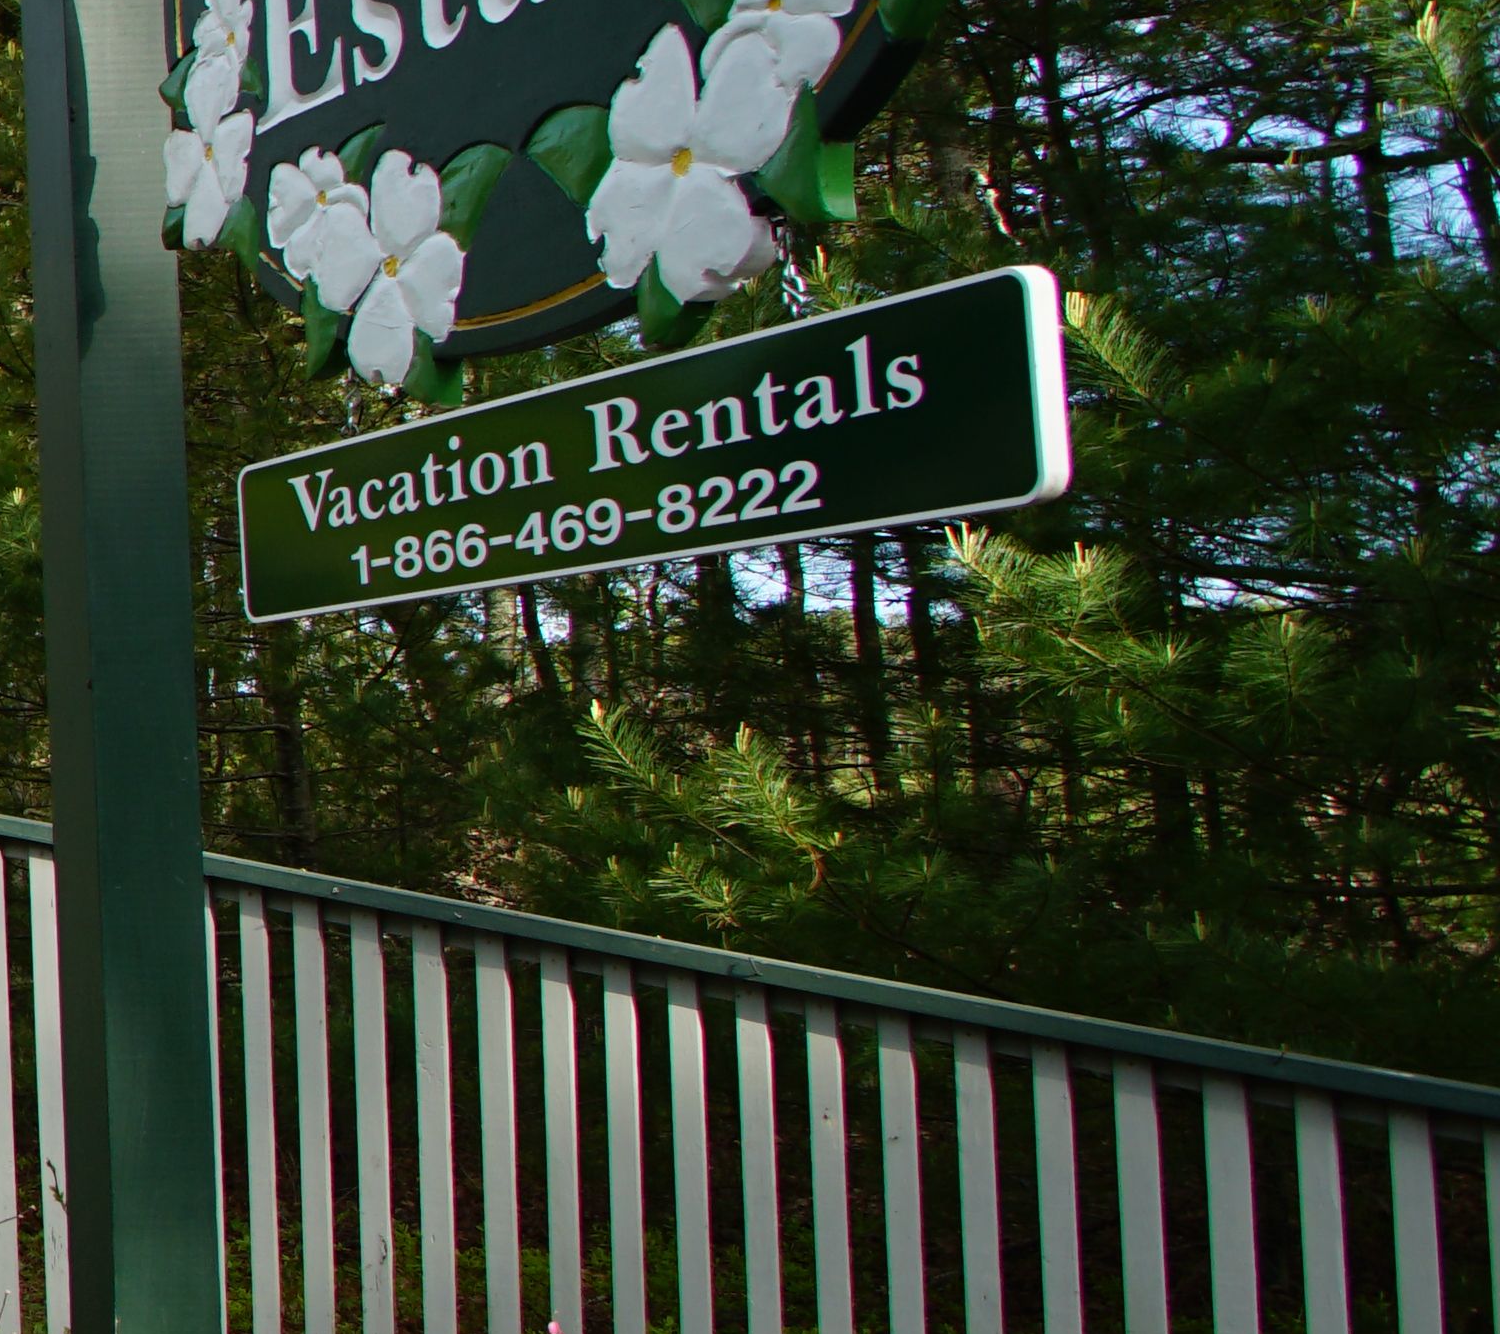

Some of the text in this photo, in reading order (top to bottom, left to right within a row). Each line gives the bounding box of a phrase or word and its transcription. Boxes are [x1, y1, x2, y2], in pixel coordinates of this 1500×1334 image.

[287, 334, 925, 532] Vacation Rentals
[350, 460, 823, 585] 1-866-469-8222
